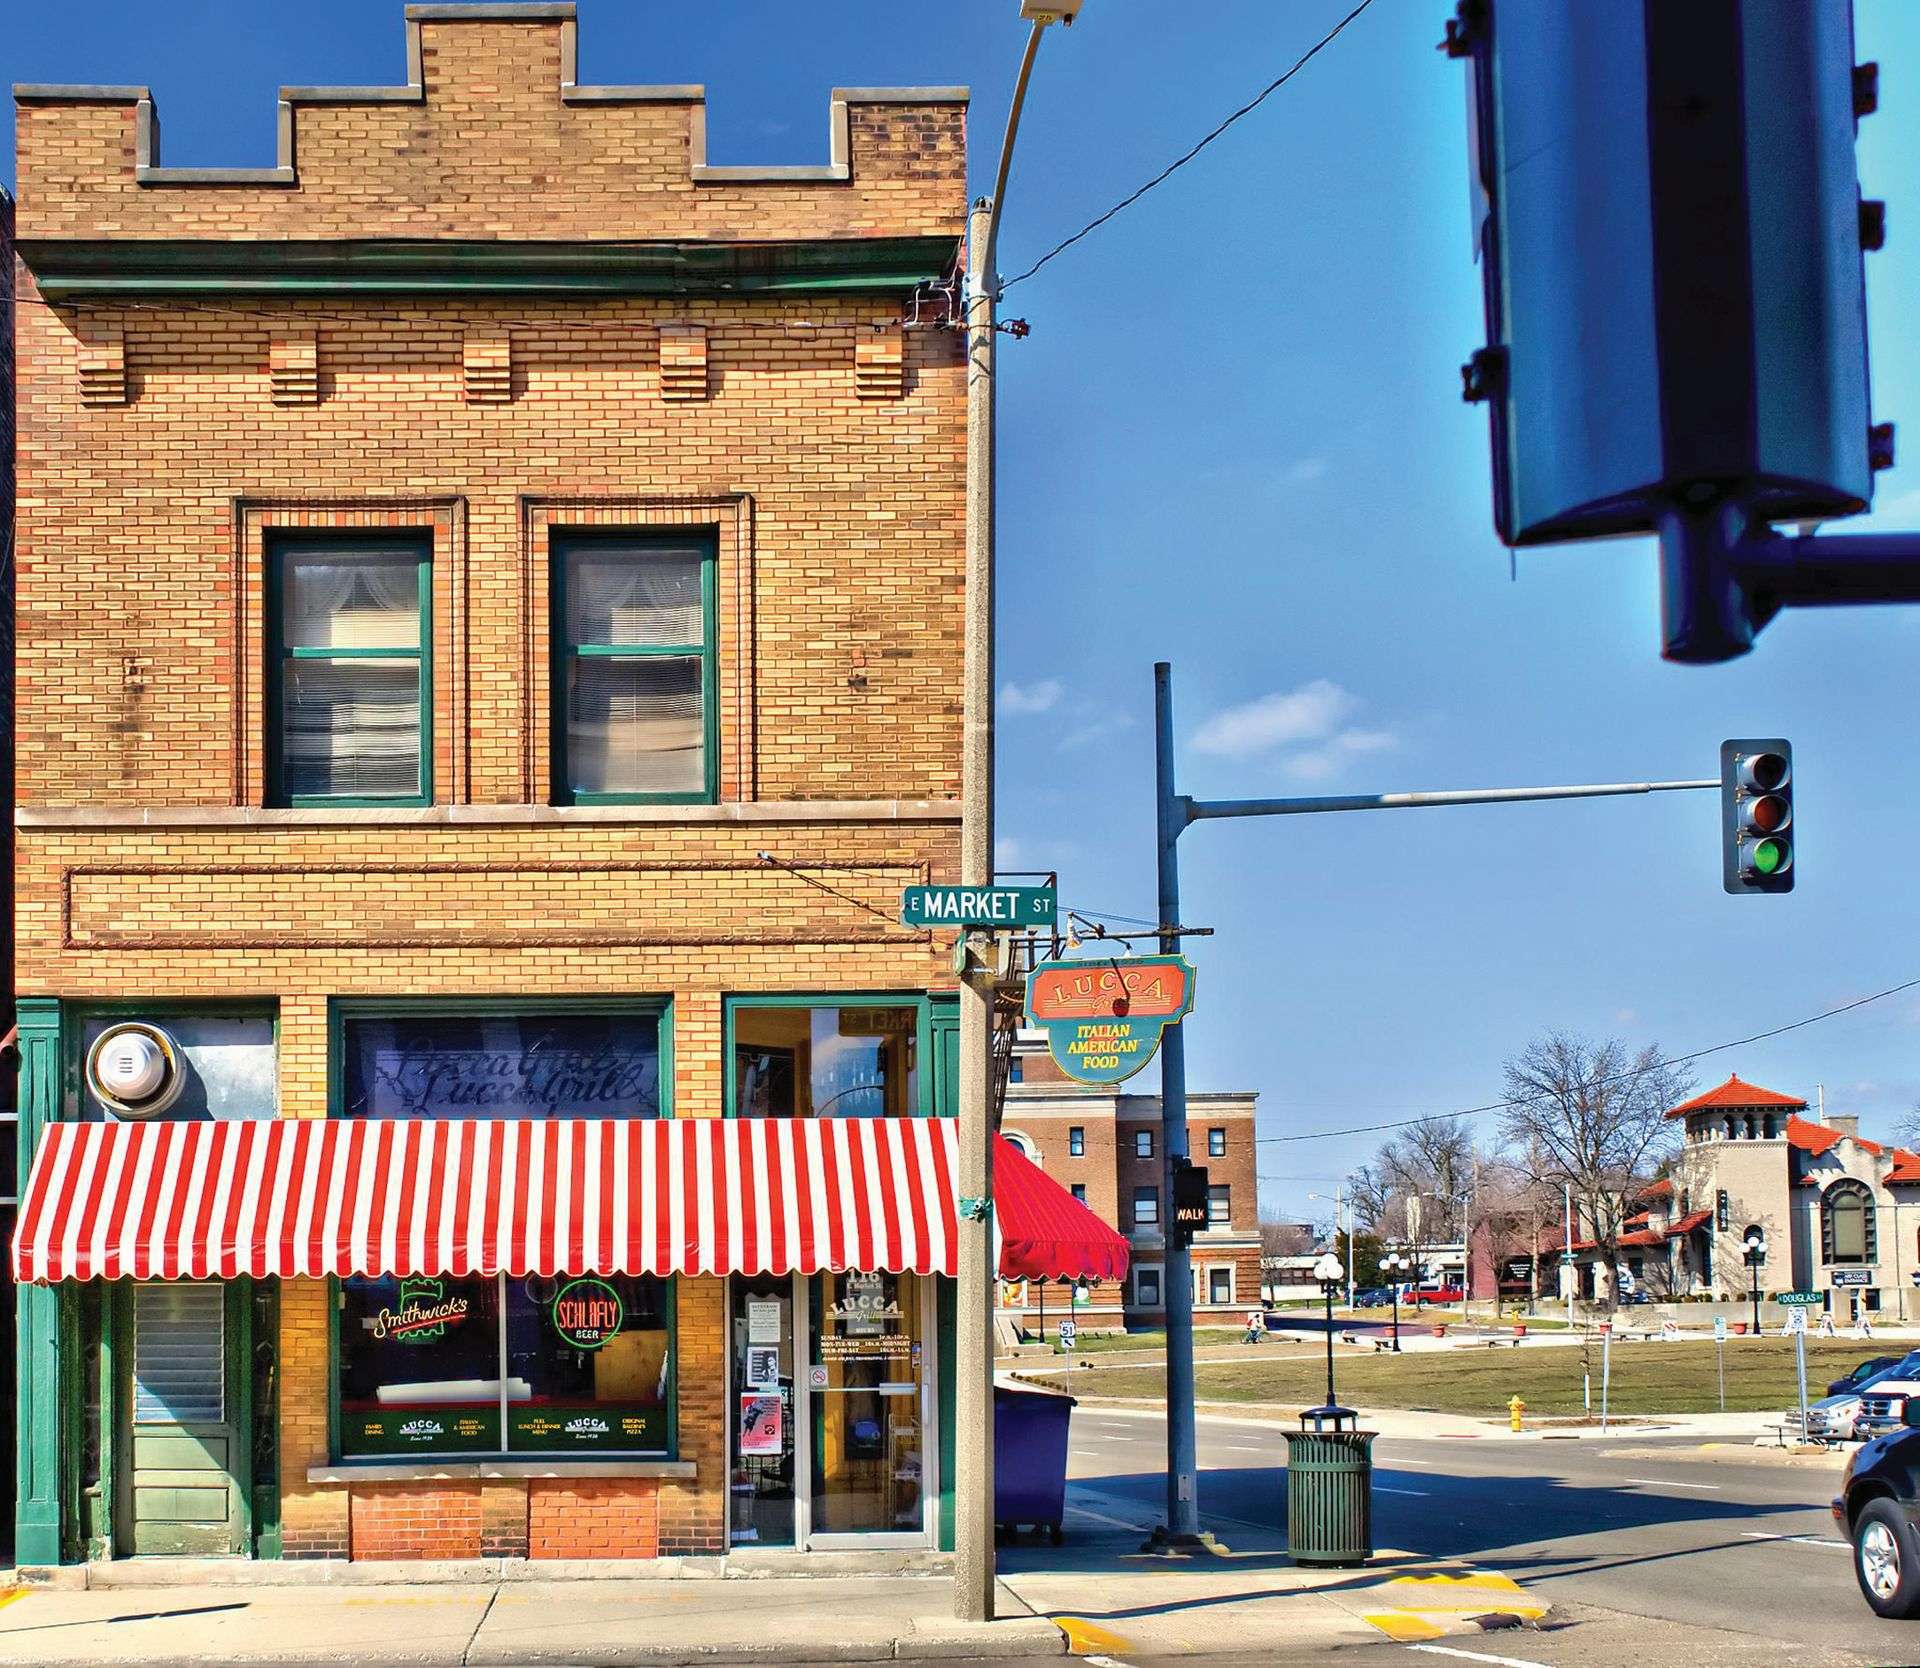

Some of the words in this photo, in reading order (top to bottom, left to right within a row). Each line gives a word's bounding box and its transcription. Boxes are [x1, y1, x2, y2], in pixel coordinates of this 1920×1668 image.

[911, 897, 919, 911] E
[924, 891, 1020, 919] MARKET
[1033, 898, 1051, 913] ST
[1054, 971, 1163, 1004] LUCCA
[1077, 1024, 1131, 1038] ITALIAN
[1067, 1039, 1138, 1054] AMERICAN
[1082, 1056, 1119, 1069] FOOD
[1177, 1208, 1205, 1220] WALK
[1782, 1293, 1816, 1303] DOUGLAS
[830, 1295, 898, 1315] LUCCA
[374, 1297, 468, 1338] Smithwick's
[559, 1301, 617, 1328] SCHLAFLY
[576, 1330, 599, 1339] BEER
[1062, 1326, 1073, 1336] 51
[402, 1419, 441, 1431] LUCCA
[567, 1417, 606, 1429] LUCCA
